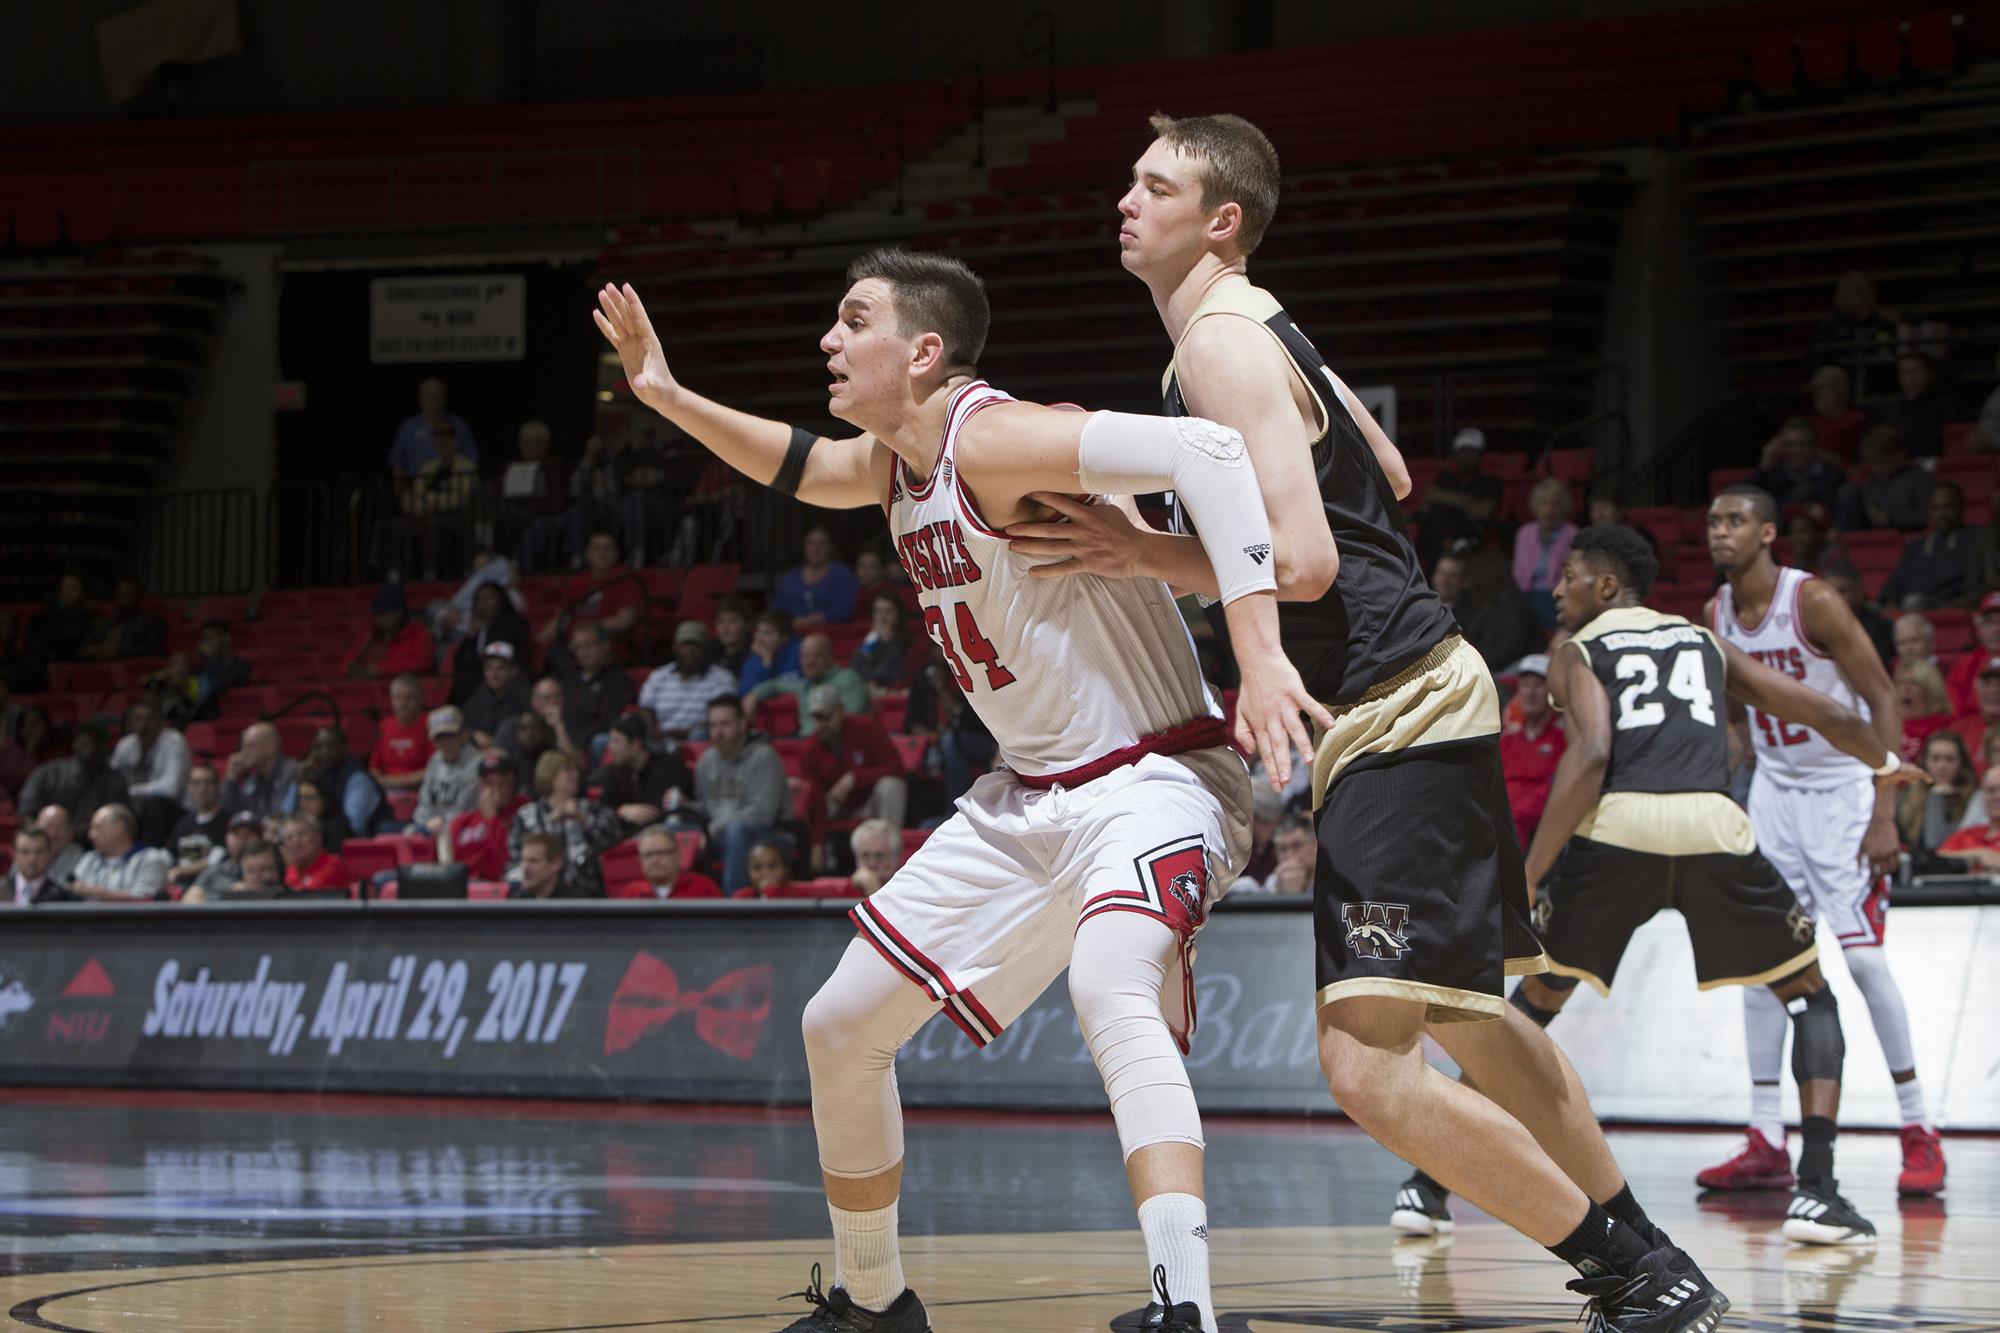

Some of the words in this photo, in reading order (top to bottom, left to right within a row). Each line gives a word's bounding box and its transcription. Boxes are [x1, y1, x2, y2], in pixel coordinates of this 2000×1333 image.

[1243, 543, 1271, 554] adidas
[924, 601, 1017, 694] 34
[1615, 649, 1717, 731] 24
[48, 1012, 111, 1040] NIU
[143, 954, 306, 1055] Saturday,
[310, 955, 416, 1056] April
[406, 960, 469, 1058] 29,
[475, 960, 587, 1043] 2017
